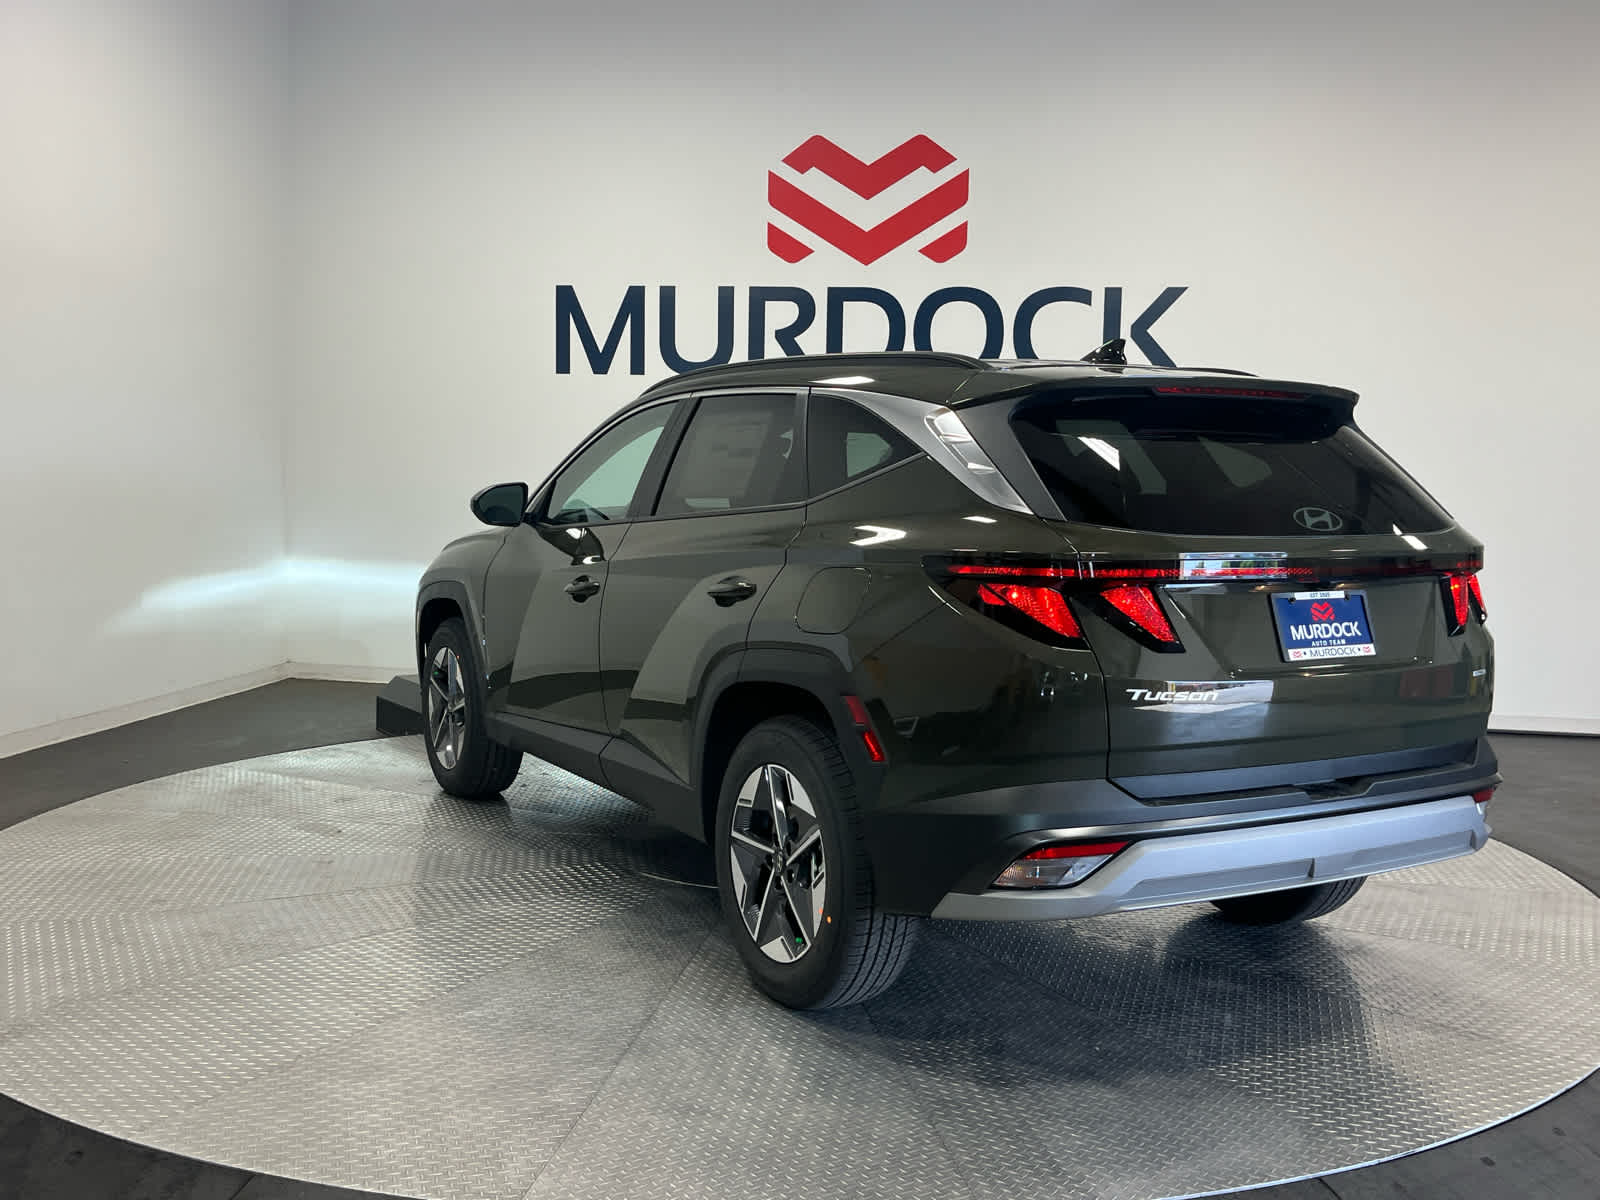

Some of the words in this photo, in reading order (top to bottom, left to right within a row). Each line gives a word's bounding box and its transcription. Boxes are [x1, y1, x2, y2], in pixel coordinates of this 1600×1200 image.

[555, 284, 1190, 376] MURDOCK
[1289, 621, 1363, 641] MURDOCK
[1311, 640, 1327, 648] AUTO
[1329, 639, 1347, 647] TEAM
[1309, 646, 1358, 658] MURDOCK
[1126, 688, 1220, 702] Tucson
